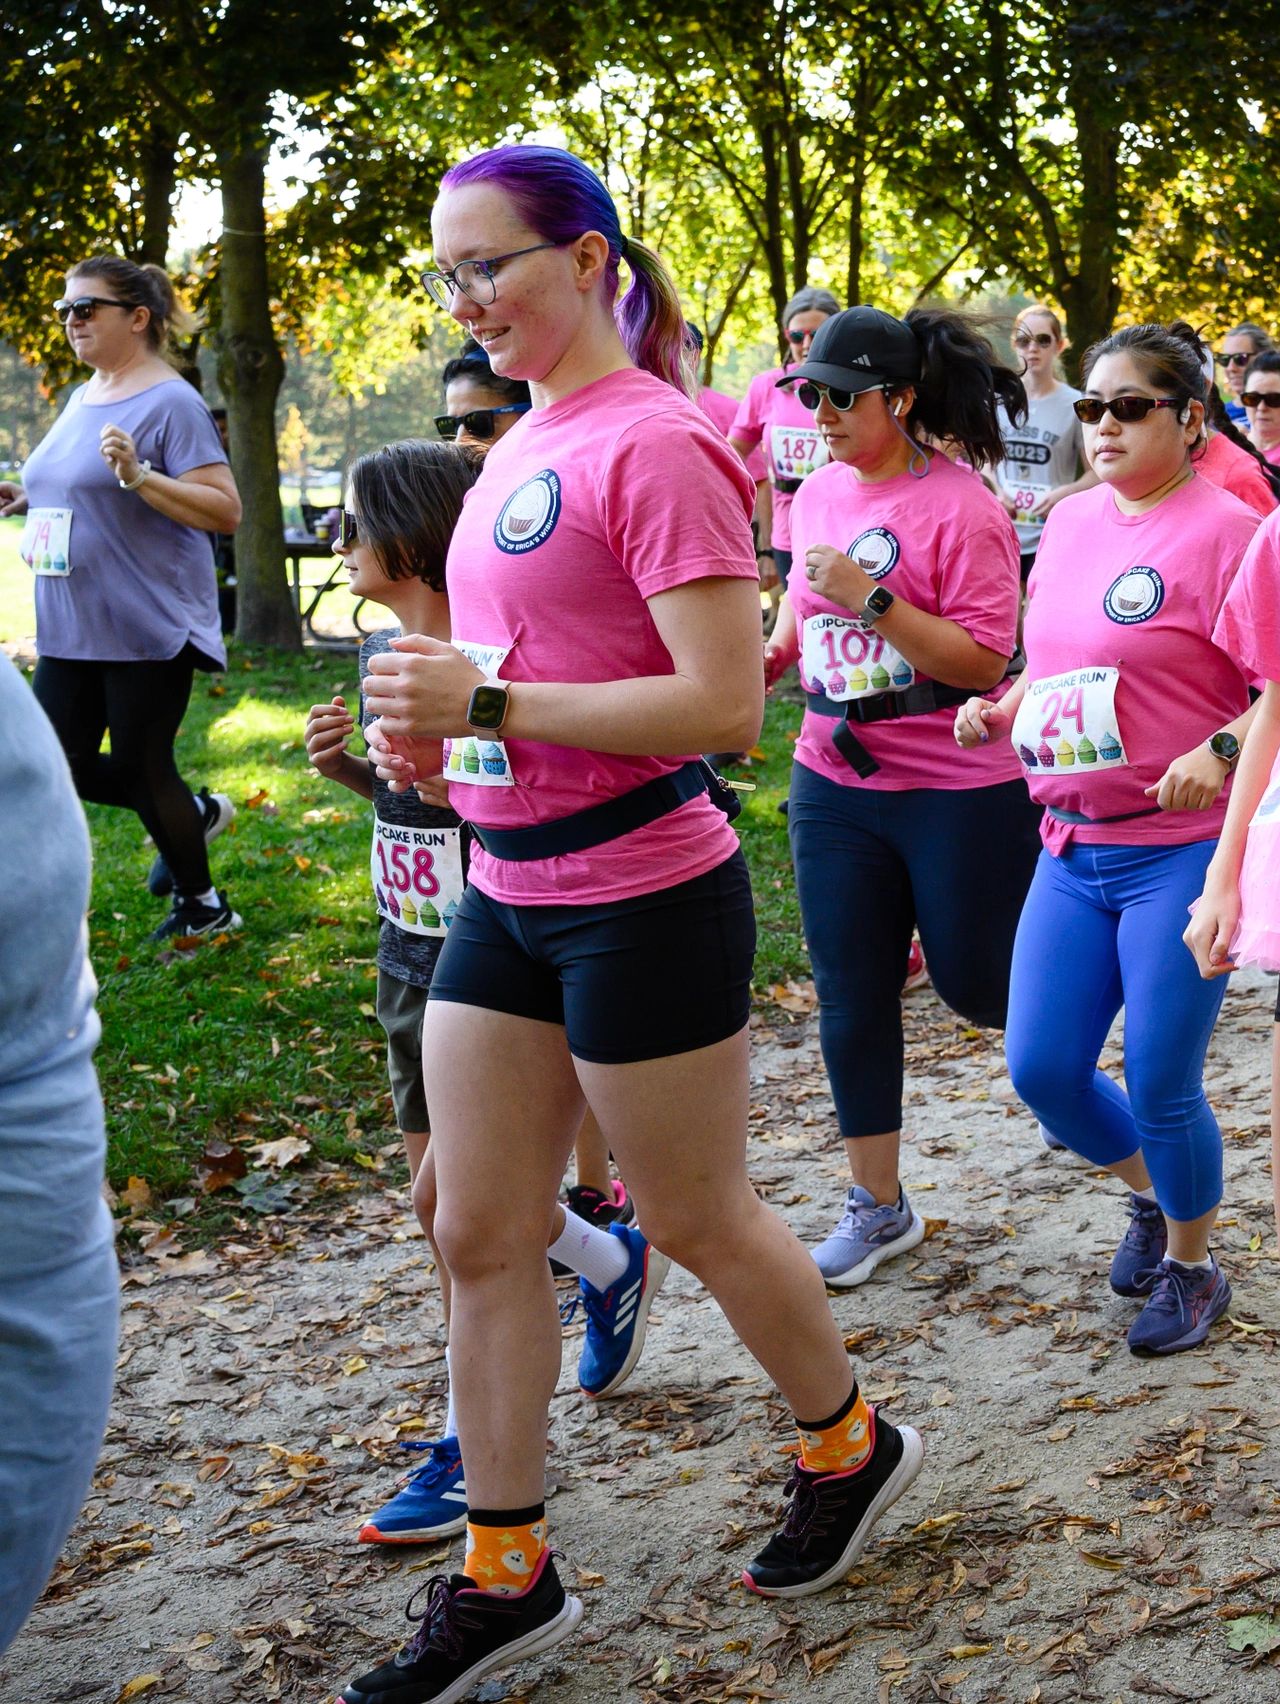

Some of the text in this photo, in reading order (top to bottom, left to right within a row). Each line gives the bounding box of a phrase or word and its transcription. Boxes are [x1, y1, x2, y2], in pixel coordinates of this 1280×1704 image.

[783, 437, 817, 462] 187
[1006, 442, 1048, 463] 2025
[1014, 490, 1035, 510] 89
[820, 628, 886, 671] 107
[1033, 671, 1107, 697] CUPCAKE RUN
[1040, 686, 1086, 739] 24
[413, 832, 446, 847] RUN
[376, 838, 441, 898] 158
